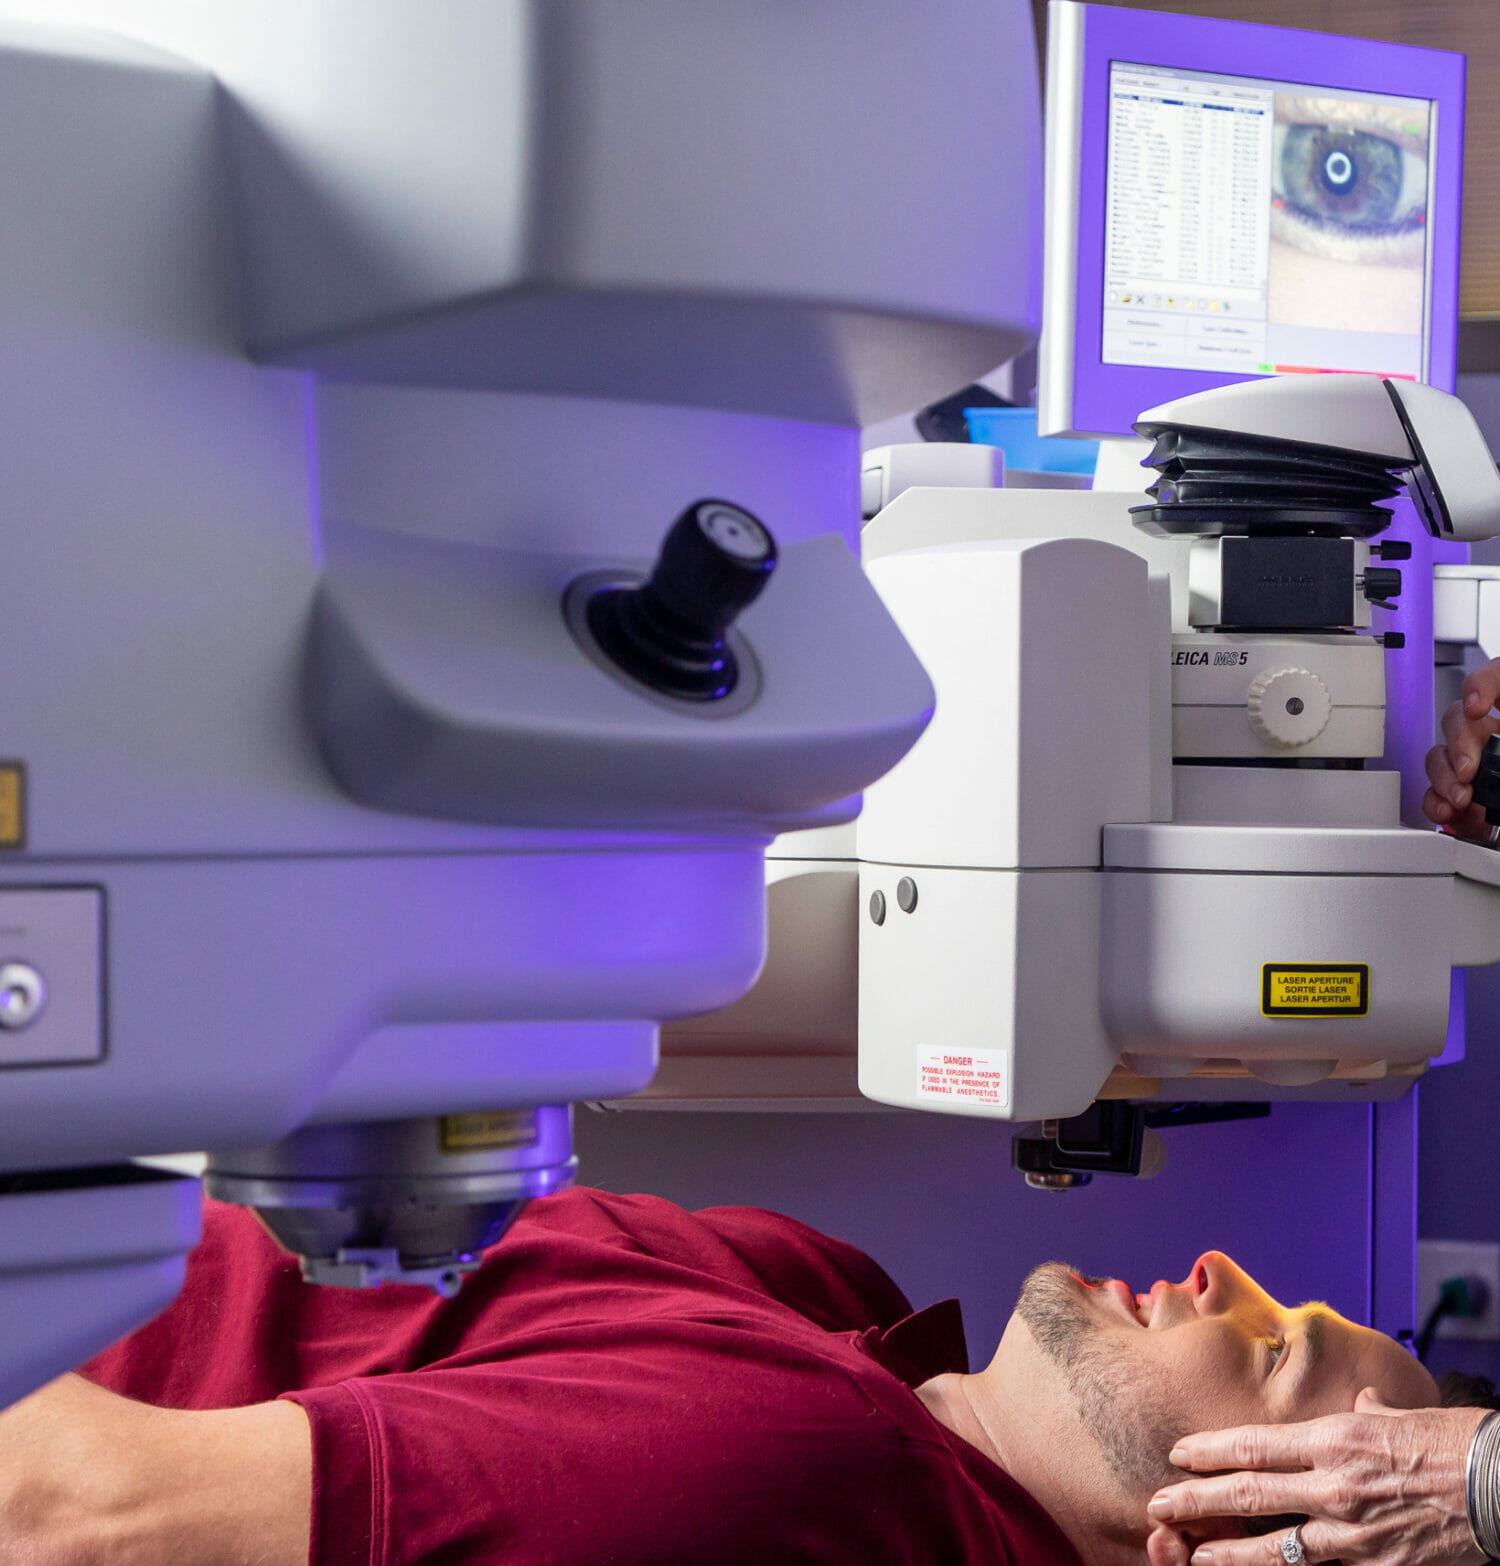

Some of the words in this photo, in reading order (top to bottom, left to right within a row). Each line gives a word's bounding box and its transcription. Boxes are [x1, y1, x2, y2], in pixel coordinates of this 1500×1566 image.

[1285, 986, 1316, 994] SORTIE
[1319, 986, 1347, 994] LASER
[1280, 995, 1309, 1003] LASER
[1311, 995, 1351, 1003] APERTUR
[943, 1056, 972, 1066] DANGER
[922, 1066, 943, 1074] POSSIBLE
[946, 1068, 974, 1077] EXPLOSION
[922, 1085, 952, 1093] FLAMMABLE
